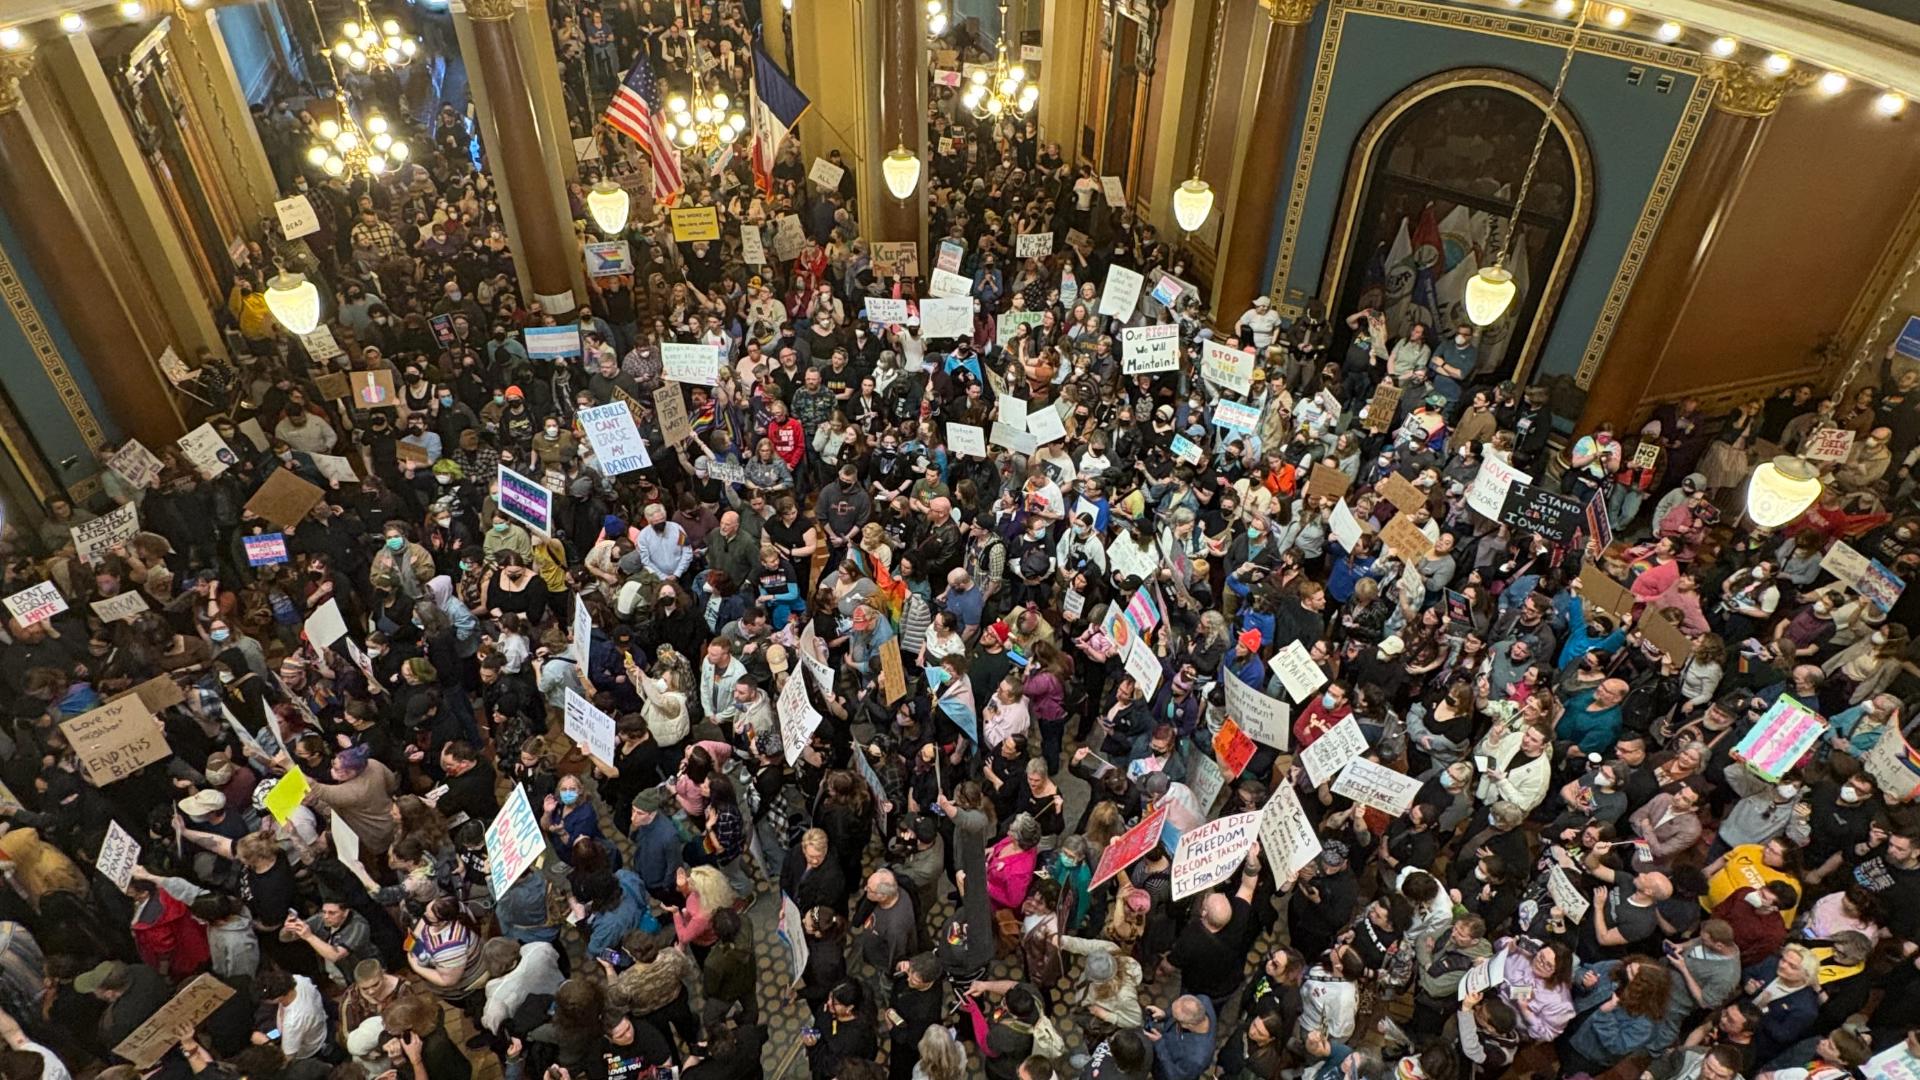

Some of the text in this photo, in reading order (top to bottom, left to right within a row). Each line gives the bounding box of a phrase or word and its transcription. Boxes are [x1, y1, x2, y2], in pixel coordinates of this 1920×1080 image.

[285, 220, 303, 231] DEAD
[1019, 233, 1052, 243] THIS WILL
[1019, 249, 1051, 257] LEGACY
[1004, 314, 1041, 325] FUND
[1125, 330, 1142, 342] Our
[1135, 342, 1166, 353] We Will
[1212, 349, 1239, 364] STOP
[1127, 351, 1176, 372] Maintain!
[1218, 361, 1235, 373] THE
[1211, 367, 1242, 386] HATE
[580, 403, 627, 422] YOUR BILLS
[597, 427, 630, 446] ERASE
[1818, 430, 1848, 440] STOP
[1821, 439, 1849, 450] BEING
[611, 445, 625, 457] MY
[1638, 449, 1656, 458] NO
[604, 455, 644, 475] IDENTITY
[1484, 461, 1513, 484] LOVE
[1514, 483, 1581, 514] I STAND
[1529, 502, 1561, 518] WITH
[77, 512, 134, 543] EXISTENCE
[79, 507, 128, 533] RESPECT
[1504, 512, 1564, 540] IOWANS
[90, 529, 131, 551] EXPECT
[12, 585, 44, 605] DONT
[25, 603, 58, 623] HATE
[70, 716, 102, 732] Love
[89, 751, 120, 772] END
[1345, 779, 1394, 804] RESISTANCE
[508, 788, 541, 858] TRANS
[1181, 814, 1256, 848] WHEN DID
[1187, 827, 1245, 860] FREEDOM
[99, 838, 113, 871] STOP
[1174, 838, 1249, 879] BECOME TAKING
[608, 1066, 627, 1076] LOVES
[628, 1062, 642, 1072] YOU
